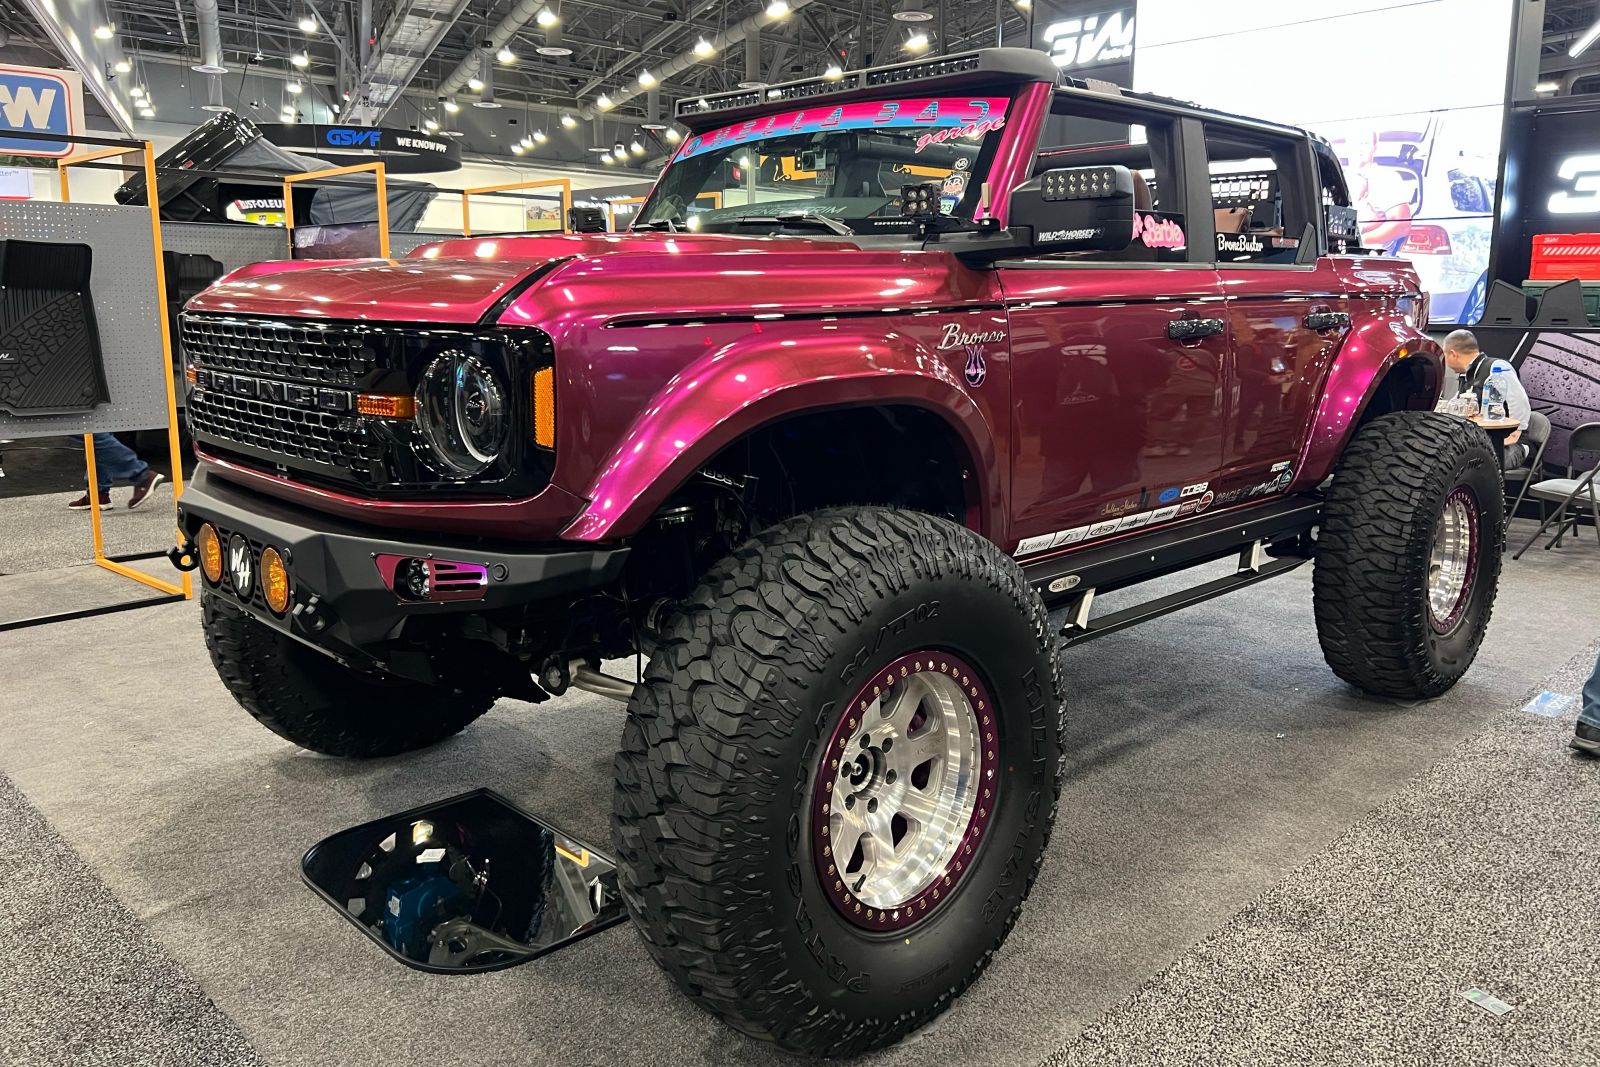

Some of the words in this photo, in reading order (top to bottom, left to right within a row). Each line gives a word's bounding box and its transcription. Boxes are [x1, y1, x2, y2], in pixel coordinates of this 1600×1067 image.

[873, 100, 990, 125] BAD
[326, 129, 382, 147] GSWF
[397, 136, 411, 148] WE
[412, 139, 435, 151] KNOW
[435, 143, 447, 153] PPF
[914, 116, 1006, 154] garage
[941, 204, 952, 212] 23
[1038, 231, 1059, 242] WILD
[1064, 228, 1096, 240] HORSES
[1142, 214, 1186, 248] Barbie
[937, 323, 1007, 350] Bronco
[197, 370, 353, 412] BRONCO
